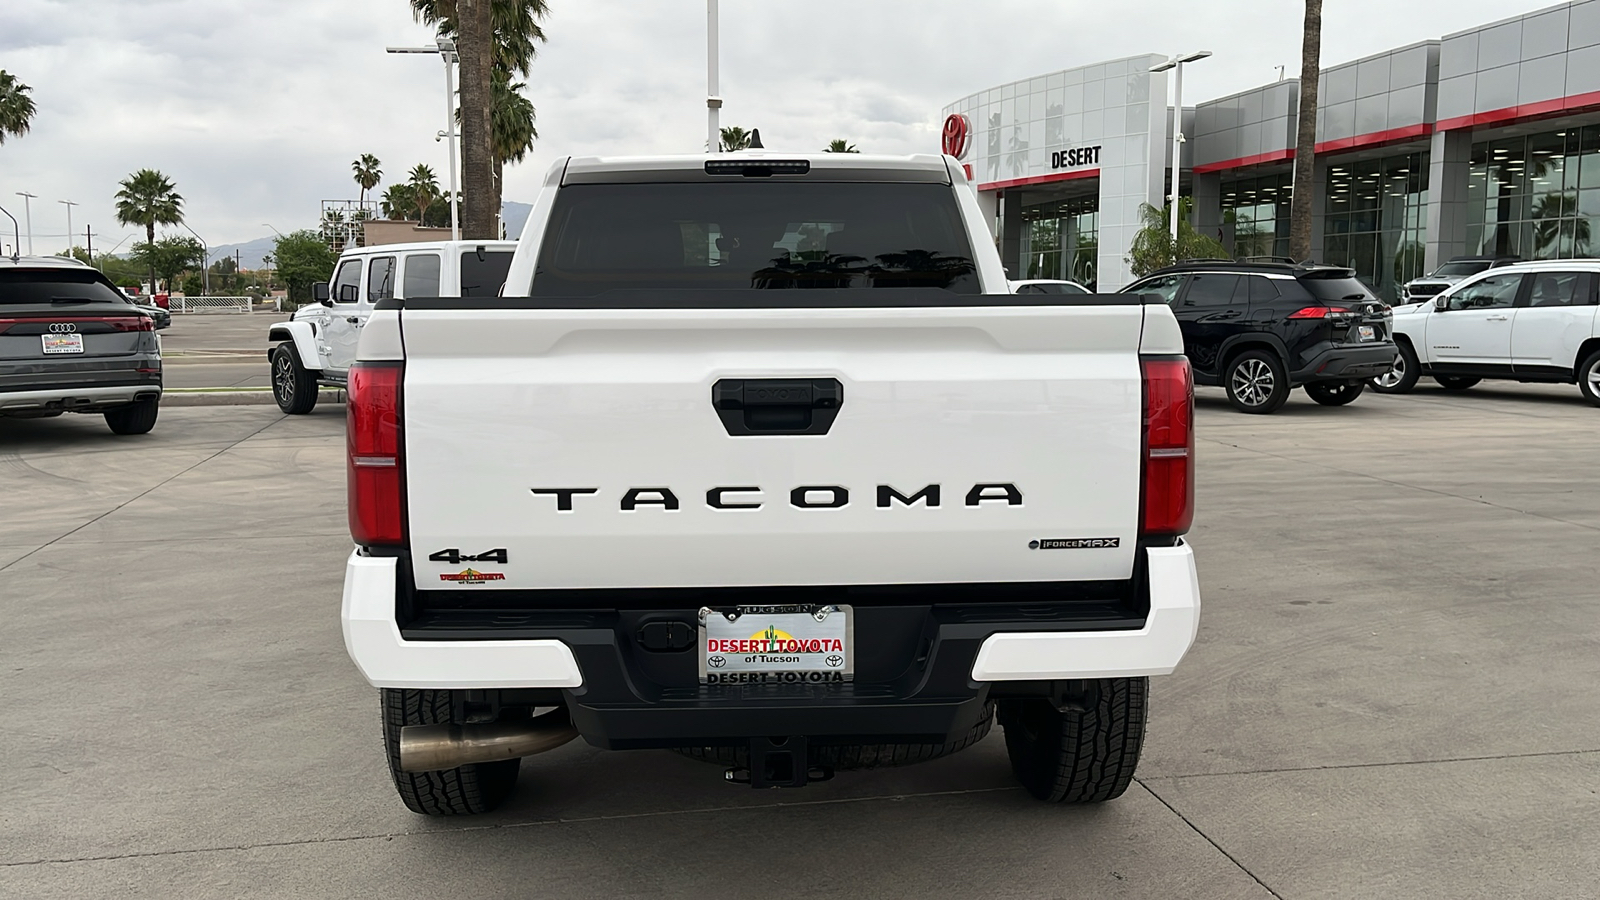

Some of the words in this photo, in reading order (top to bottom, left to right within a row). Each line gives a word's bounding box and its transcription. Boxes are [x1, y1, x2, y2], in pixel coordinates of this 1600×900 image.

[1051, 146, 1102, 169] DESERT
[747, 388, 809, 399] TOYOTA
[530, 483, 1024, 511] TACOMA
[428, 548, 508, 564] 4x4
[707, 639, 770, 653] DESERT
[776, 639, 843, 653] TOYOTA
[744, 655, 757, 663] of
[759, 655, 800, 663] Tucson
[706, 672, 769, 684] DESERT
[775, 671, 844, 683] TOYOTA
